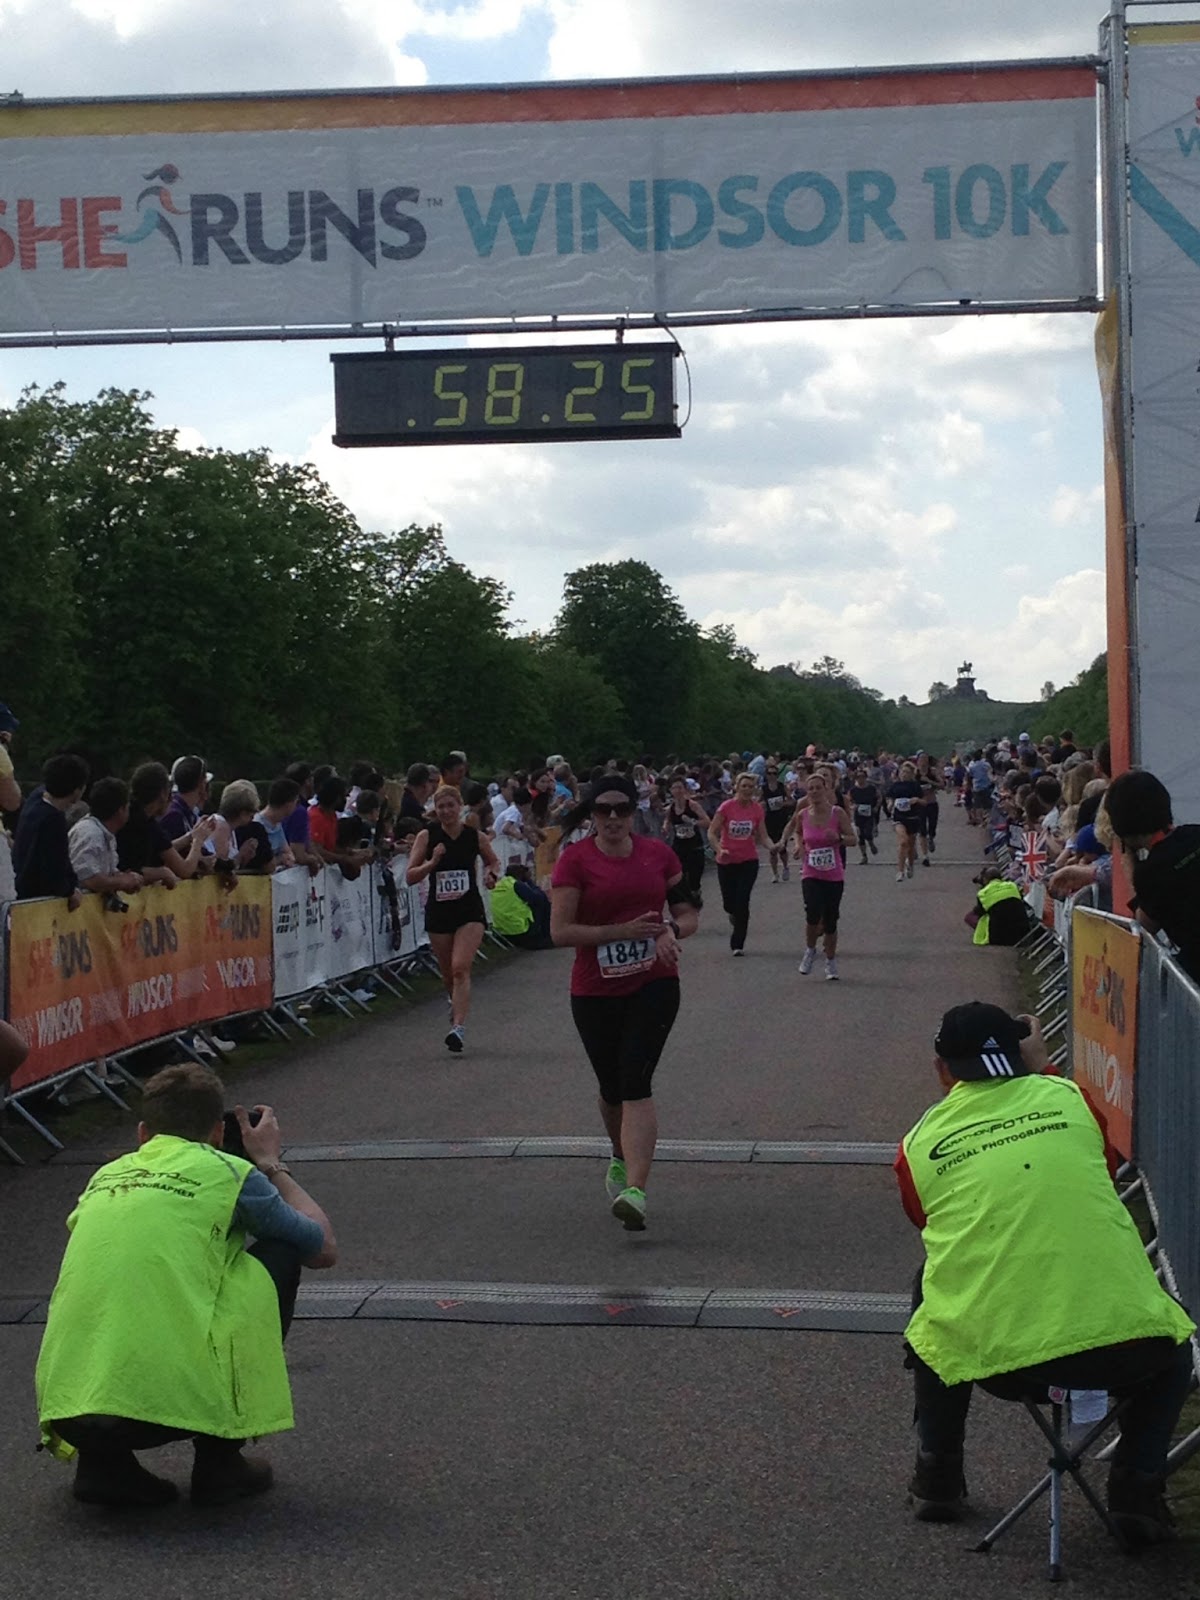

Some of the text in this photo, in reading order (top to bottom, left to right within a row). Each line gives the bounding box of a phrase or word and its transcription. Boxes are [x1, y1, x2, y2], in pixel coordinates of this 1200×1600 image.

[191, 186, 426, 268] RUNS
[456, 169, 908, 258] WINDSOR
[921, 161, 1071, 241] 10K
[439, 878, 464, 893] 1031
[606, 939, 648, 965] 1847
[936, 1121, 1069, 1177] OFFICIAL PHOTOGRAPHER
